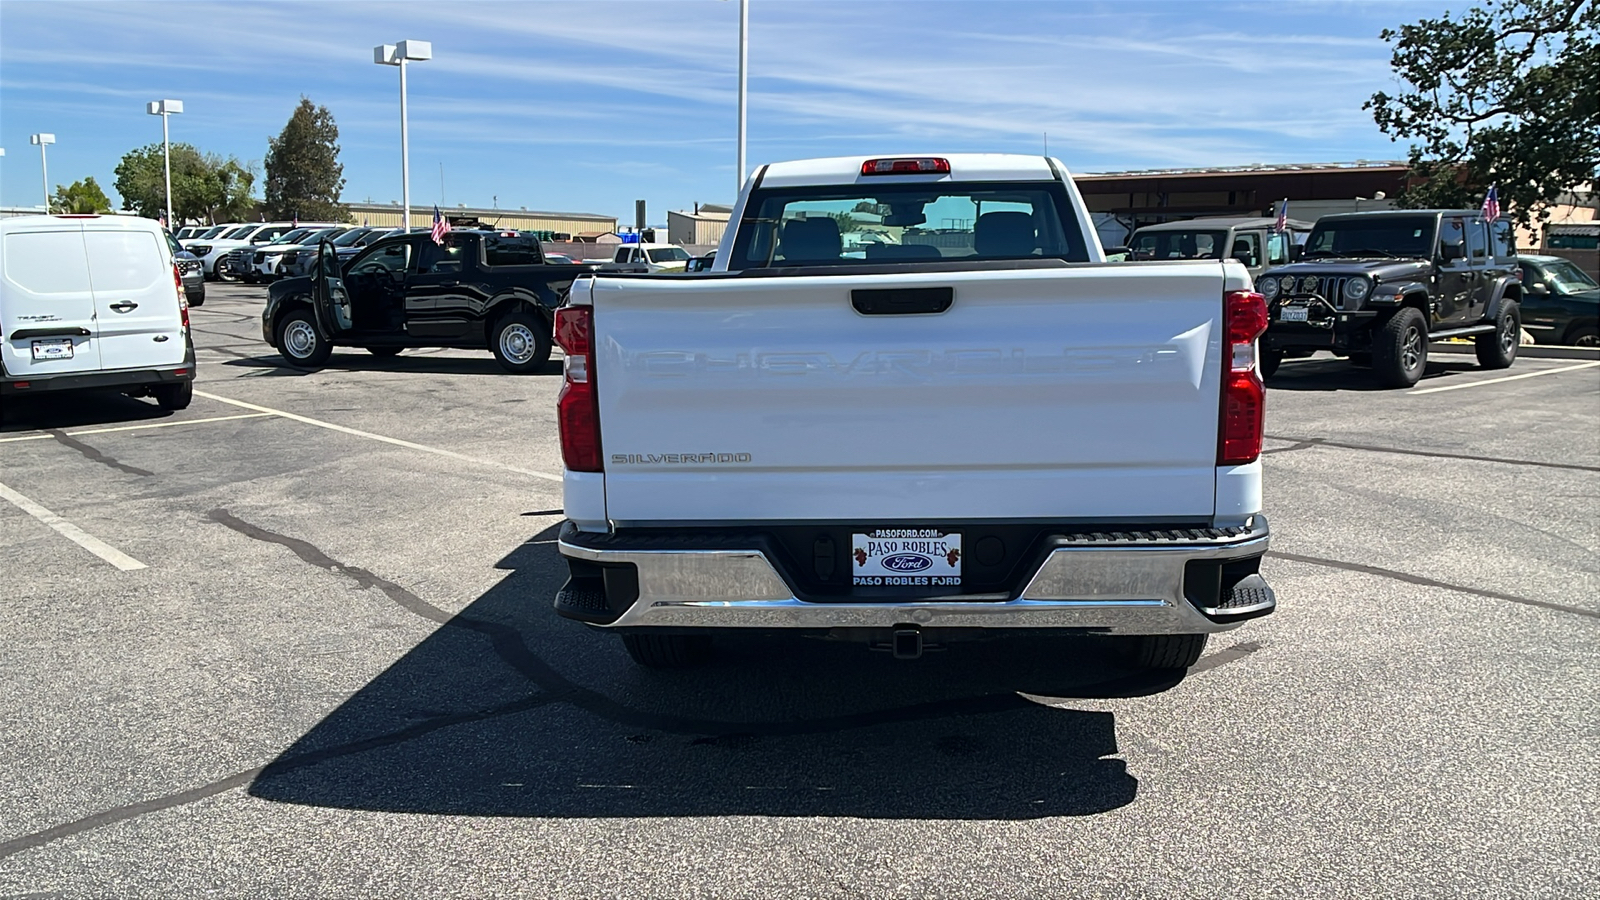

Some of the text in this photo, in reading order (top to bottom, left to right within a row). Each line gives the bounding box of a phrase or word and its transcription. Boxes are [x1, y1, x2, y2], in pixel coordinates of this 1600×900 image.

[611, 452, 752, 464] SILVERADO
[875, 529, 938, 538] PASOFORD.COM
[867, 541, 948, 558] PASO ROBLES
[891, 556, 923, 569] Ford
[853, 577, 962, 586] PASO ROBLES FORD
